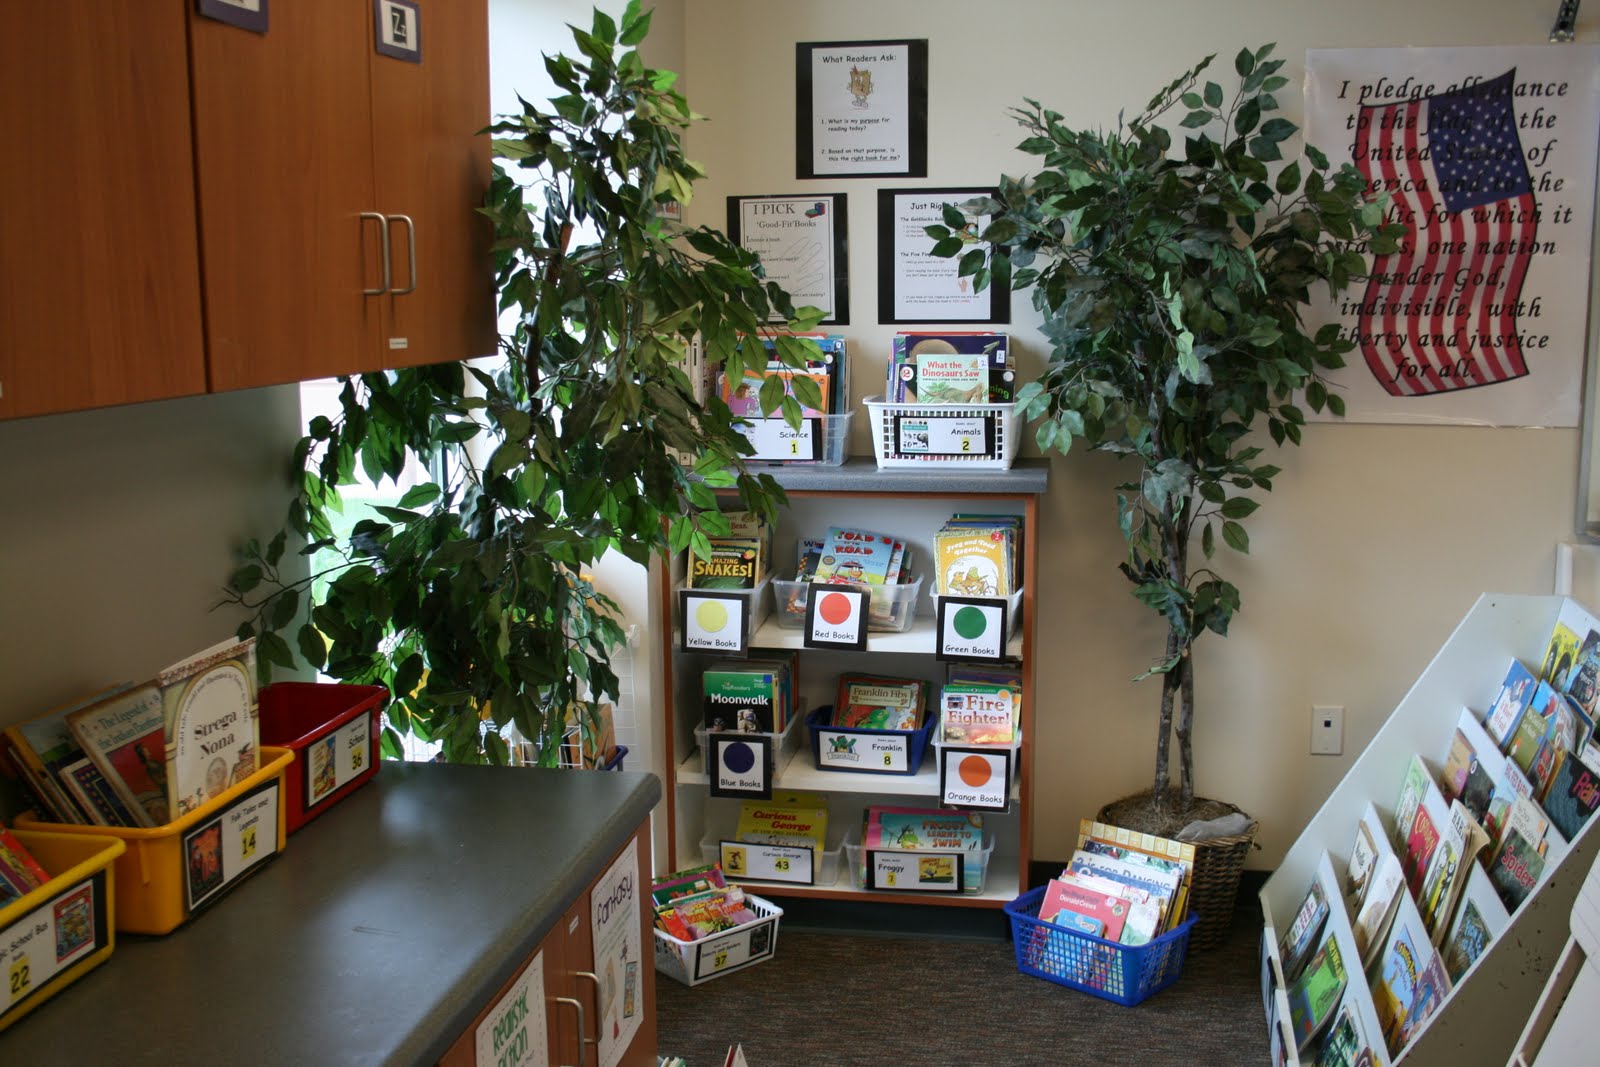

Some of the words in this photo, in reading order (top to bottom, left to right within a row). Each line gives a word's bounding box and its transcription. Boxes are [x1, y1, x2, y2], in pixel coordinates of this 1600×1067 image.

[822, 56, 843, 64] What
[1338, 80, 1350, 98] I
[1358, 77, 1436, 104] pledge
[1347, 115, 1369, 130] to
[1381, 110, 1416, 130] the
[1520, 108, 1556, 128] the
[1348, 143, 1430, 162] United
[1528, 140, 1558, 167] of
[1363, 177, 1428, 192] erica
[1438, 175, 1484, 192] and
[1528, 172, 1564, 192] the
[753, 204, 758, 214] I
[762, 203, 796, 214] PICK
[1420, 204, 1460, 230] for
[1471, 204, 1542, 224] which
[1554, 206, 1572, 224] it
[1428, 240, 1467, 254] one
[1478, 236, 1556, 254] nation
[1376, 266, 1444, 286] under
[1454, 268, 1506, 292] God,
[1341, 297, 1472, 320] indivisible,
[1486, 297, 1542, 318] with
[1338, 329, 1408, 355] iberty
[1417, 330, 1462, 348] and
[1469, 329, 1550, 353] justice
[928, 361, 948, 369] What
[950, 361, 962, 369] the
[1390, 358, 1432, 383] for
[1438, 358, 1476, 378] all.
[902, 368, 911, 378] 2
[922, 368, 963, 377] Dinosaurs
[965, 368, 980, 377] Saw
[951, 428, 981, 436] Animals
[792, 444, 797, 454] 1
[963, 441, 970, 450] 2
[835, 545, 874, 555] ROAD
[946, 543, 960, 554] Frog
[978, 541, 996, 550] Toad
[954, 547, 988, 556] Together
[694, 560, 752, 578] SNAKES!
[815, 630, 830, 638] Red
[832, 632, 854, 640] Books
[688, 638, 712, 646] Yellow
[944, 645, 969, 654] Green
[972, 646, 995, 655] Books
[853, 687, 888, 698] Franklin
[890, 690, 908, 698] Fibs
[710, 693, 768, 706] Moonwalk
[966, 694, 1005, 712] Fire
[948, 710, 1010, 726] Fighter!
[194, 712, 238, 742] Strega
[348, 730, 366, 748] School
[200, 732, 236, 760] Nona
[872, 744, 902, 752] Franklin
[352, 752, 362, 770] 36
[884, 756, 891, 765] 8
[740, 780, 760, 788] Books
[1572, 771, 1600, 810] Rain
[948, 792, 976, 802] Orange
[980, 794, 1003, 804] Books
[752, 810, 797, 822] Curious
[771, 820, 812, 832] George
[922, 820, 965, 830] FROGGY
[242, 832, 256, 856] 14
[932, 838, 962, 848] SWIM
[775, 861, 790, 870] 43
[878, 864, 904, 873] Froggy
[1501, 845, 1538, 888] Spiders
[1060, 894, 1080, 905] Donald
[11, 928, 34, 952] School
[35, 922, 48, 935] Bus
[715, 955, 726, 966] 37
[10, 965, 32, 994] 22
